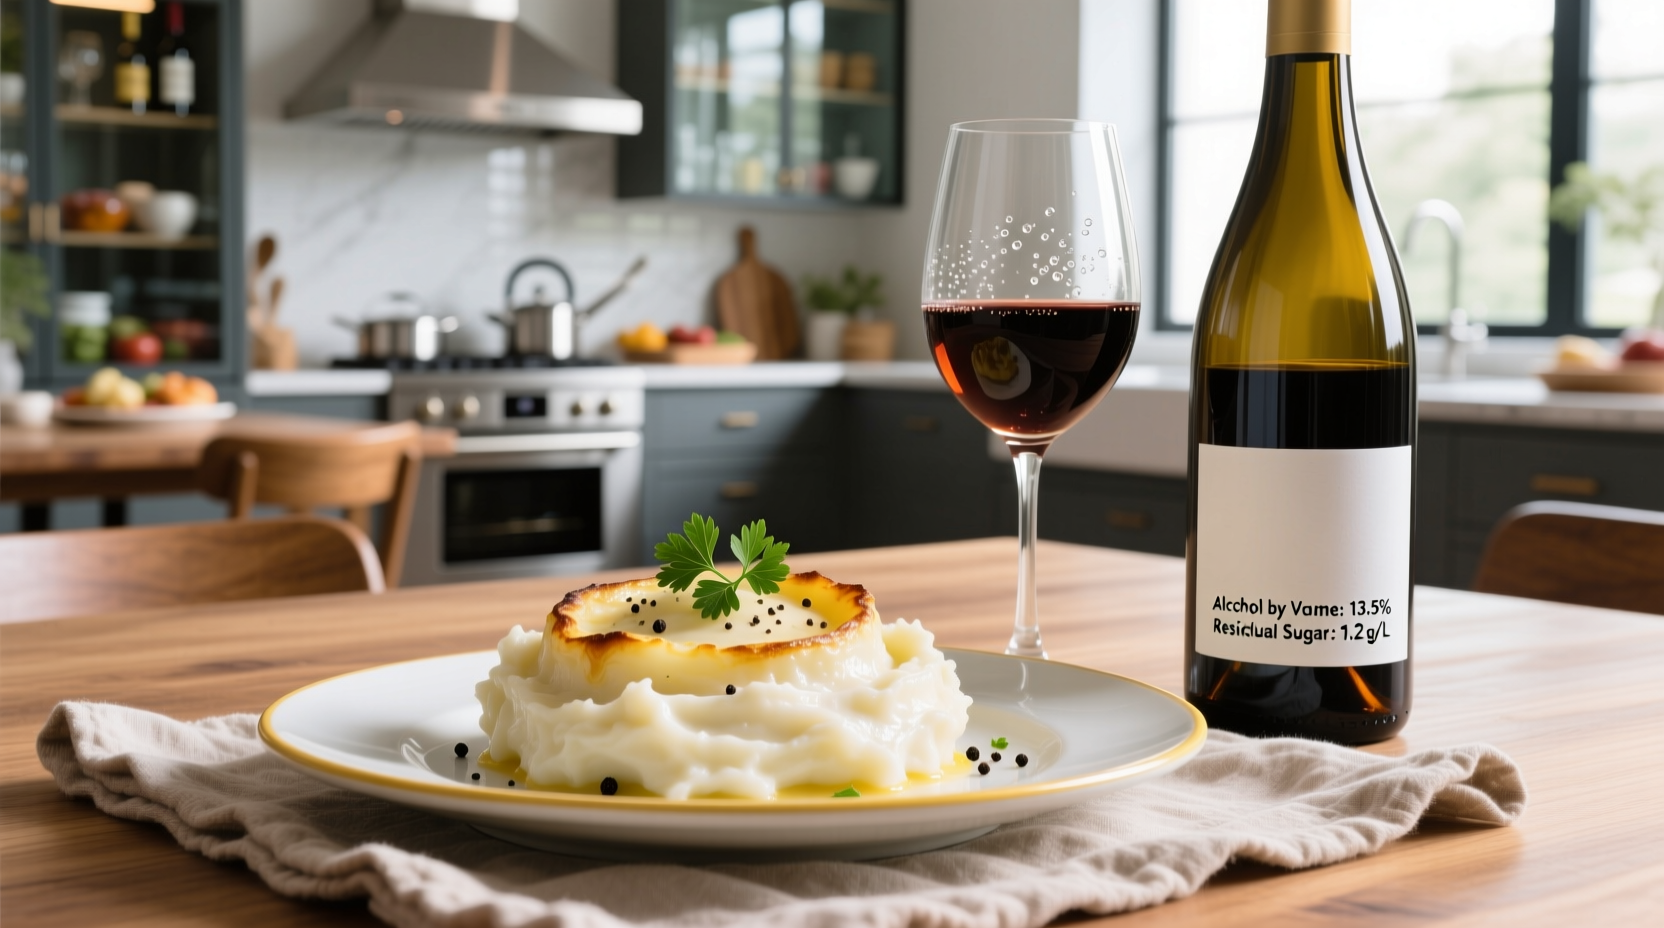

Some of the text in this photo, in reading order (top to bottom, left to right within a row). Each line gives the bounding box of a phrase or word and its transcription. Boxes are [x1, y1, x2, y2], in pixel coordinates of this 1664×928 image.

[1268, 598, 1287, 621] by
[1349, 598, 1392, 616] 13.5%
[1283, 623, 1336, 645] Sugar:
